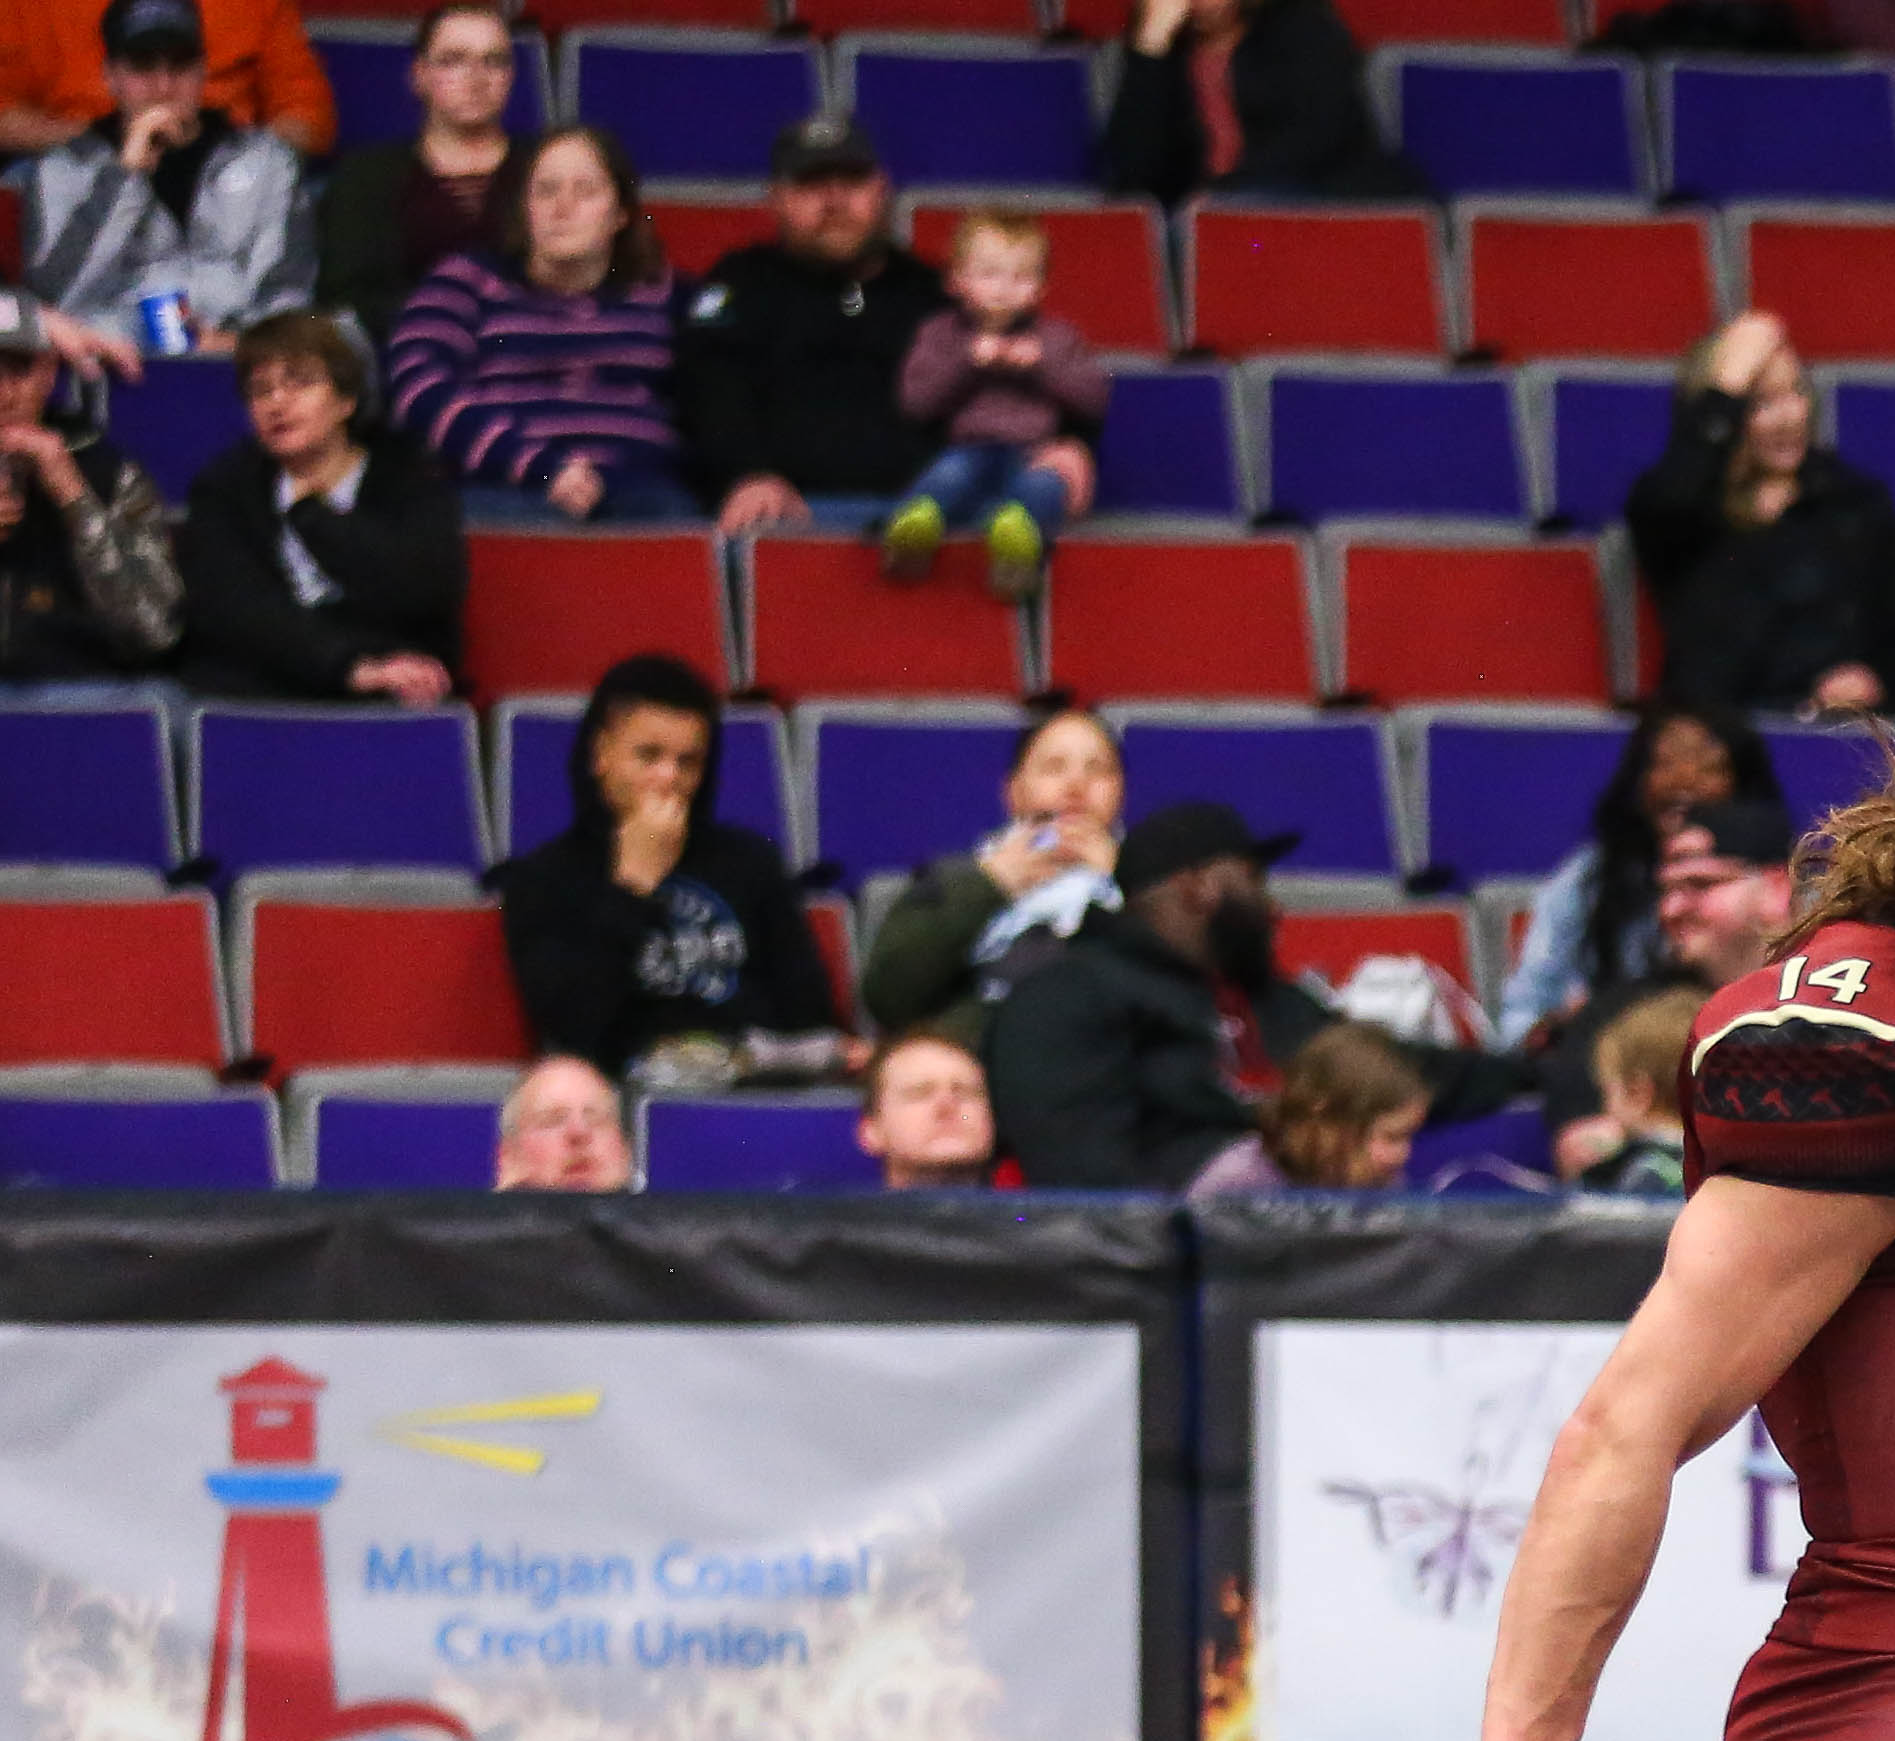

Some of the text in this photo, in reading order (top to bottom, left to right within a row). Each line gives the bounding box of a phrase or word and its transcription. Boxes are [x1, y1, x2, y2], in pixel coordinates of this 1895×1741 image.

[1776, 955, 1872, 1005] 14
[364, 1538, 872, 1609] Michigan Coastal
[434, 1611, 811, 1670] Credit Union
